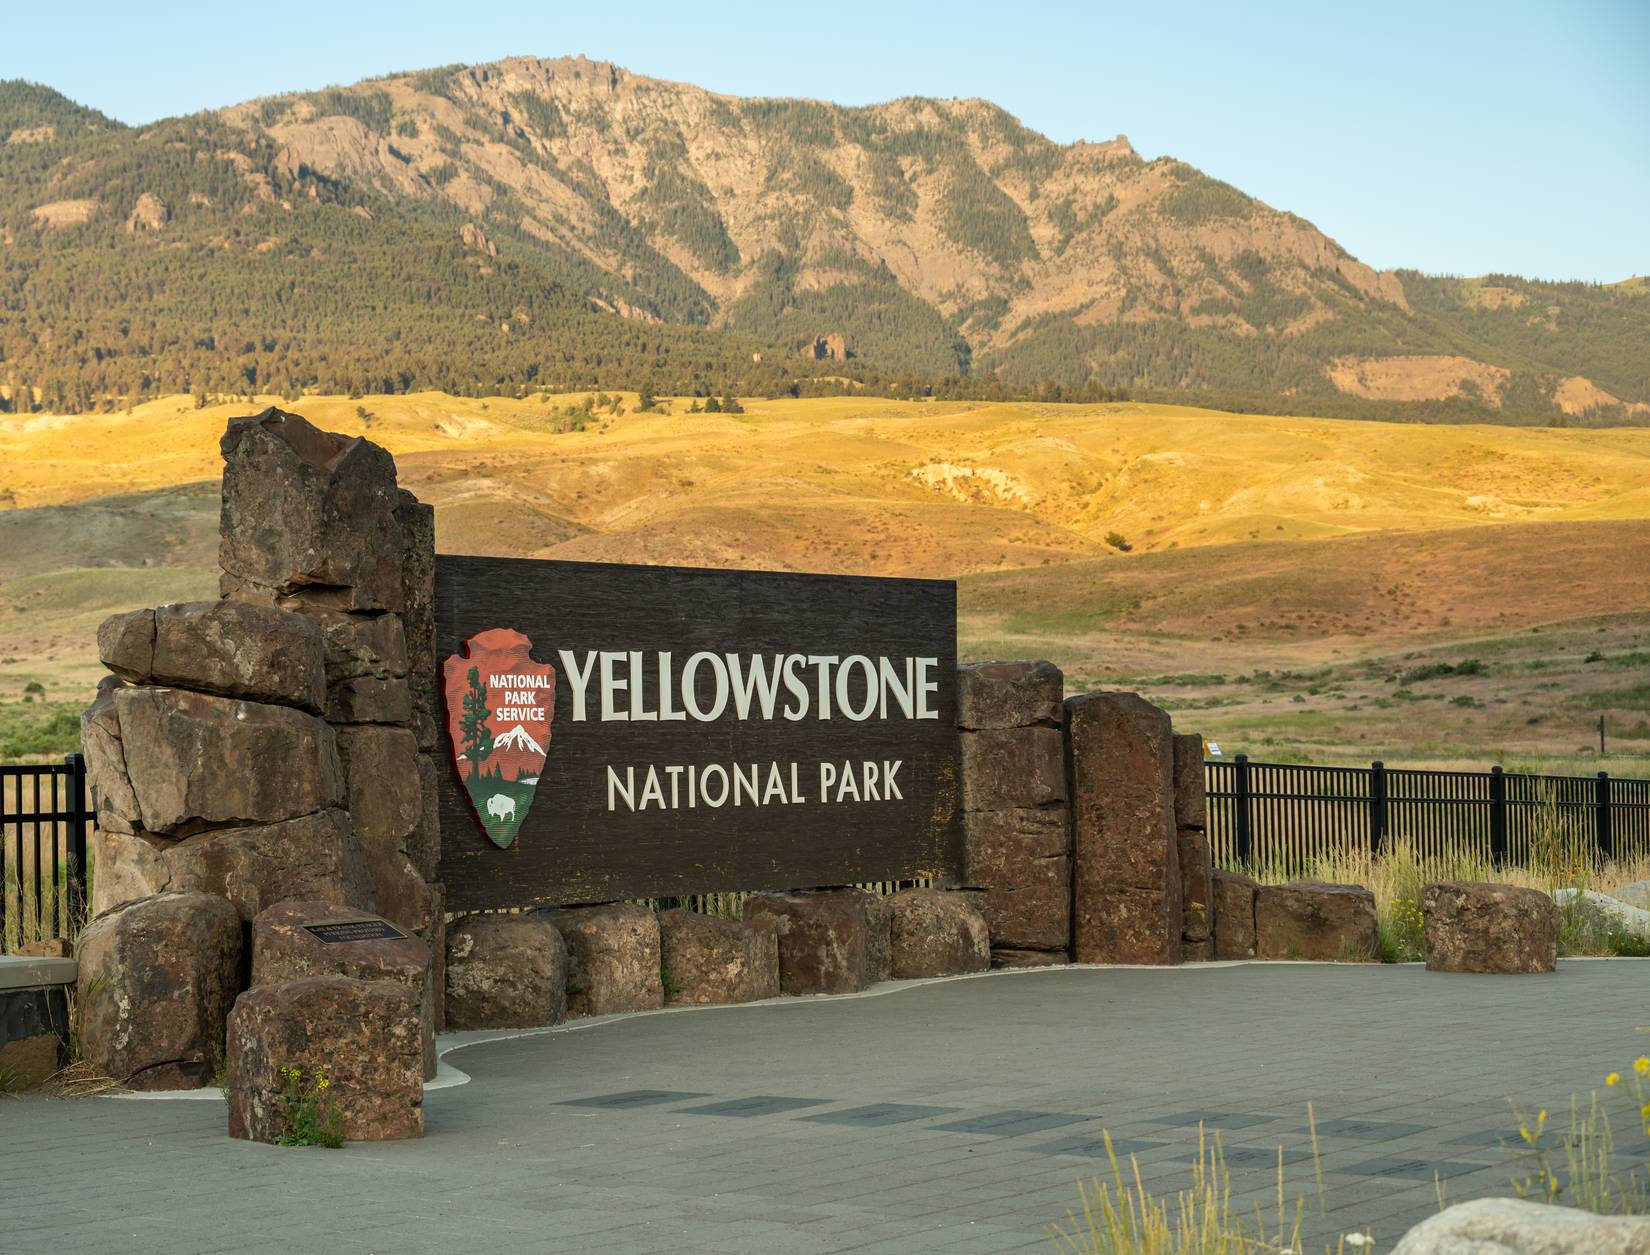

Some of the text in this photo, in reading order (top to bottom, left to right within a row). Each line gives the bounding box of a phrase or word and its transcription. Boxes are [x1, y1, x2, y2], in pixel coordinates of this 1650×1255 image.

[489, 674, 551, 689] NATIONAL
[558, 650, 939, 722] YELLOWSTONE
[504, 691, 537, 705] PARK
[496, 707, 545, 721] SERVICE
[607, 760, 904, 812] NATIONAL PARK
